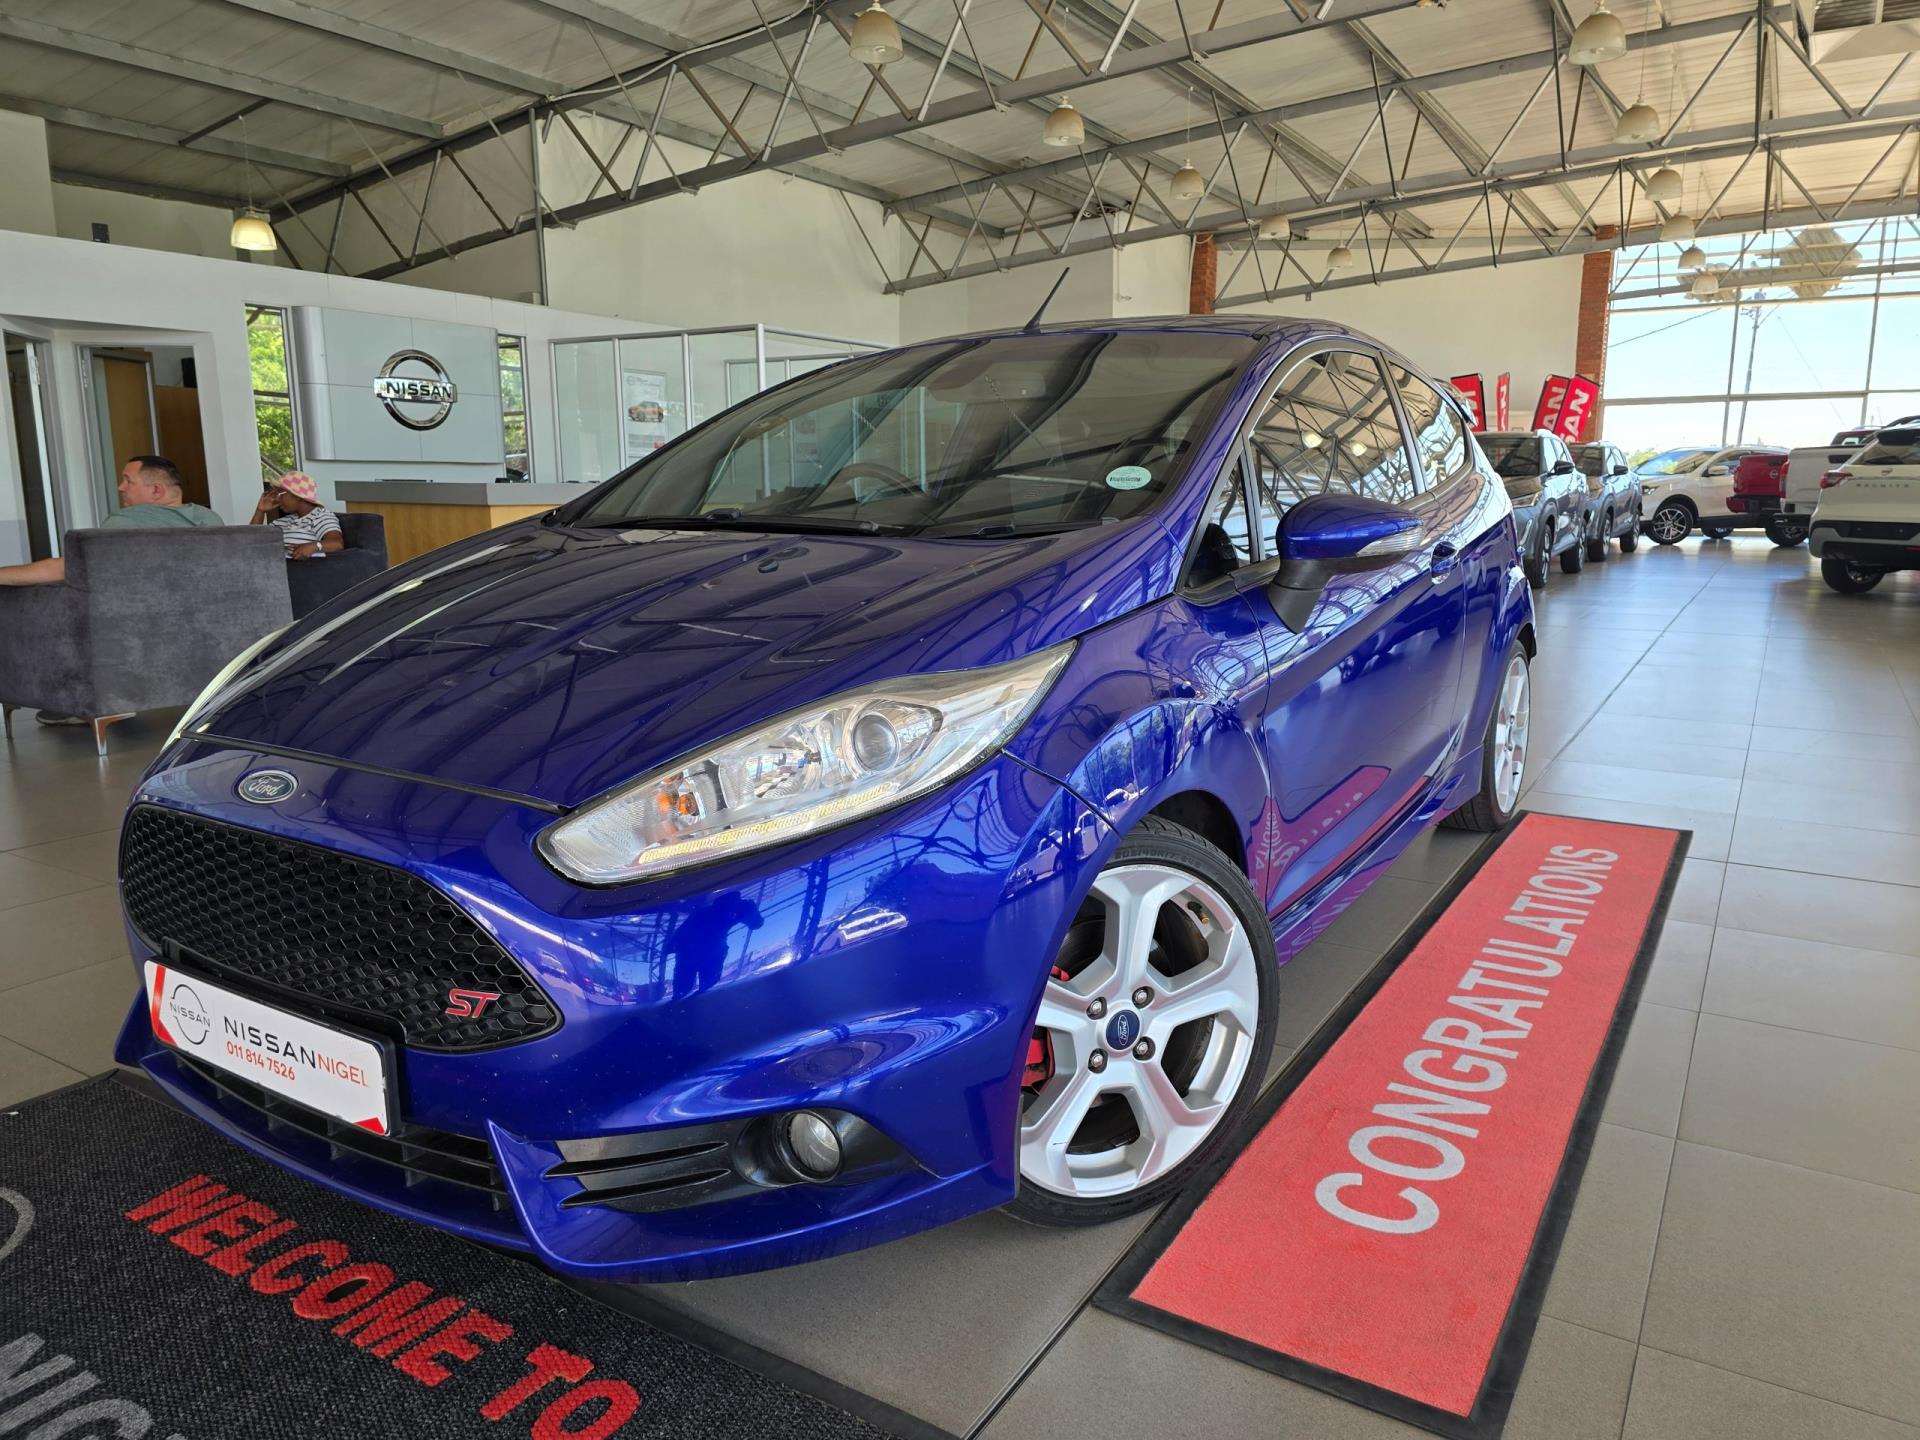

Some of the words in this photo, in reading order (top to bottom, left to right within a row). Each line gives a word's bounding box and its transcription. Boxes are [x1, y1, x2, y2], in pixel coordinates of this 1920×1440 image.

[386, 381, 451, 398] NISSAN
[169, 1001, 211, 1028] NISSAN
[445, 988, 500, 1018] ST
[1315, 844, 1620, 1235] CONGRATULATIONS
[226, 1041, 244, 1062] 011
[246, 1049, 264, 1069] 814
[267, 1057, 296, 1081] 7526
[124, 1174, 514, 1388] WELCOME
[480, 1342, 641, 1440] TO
